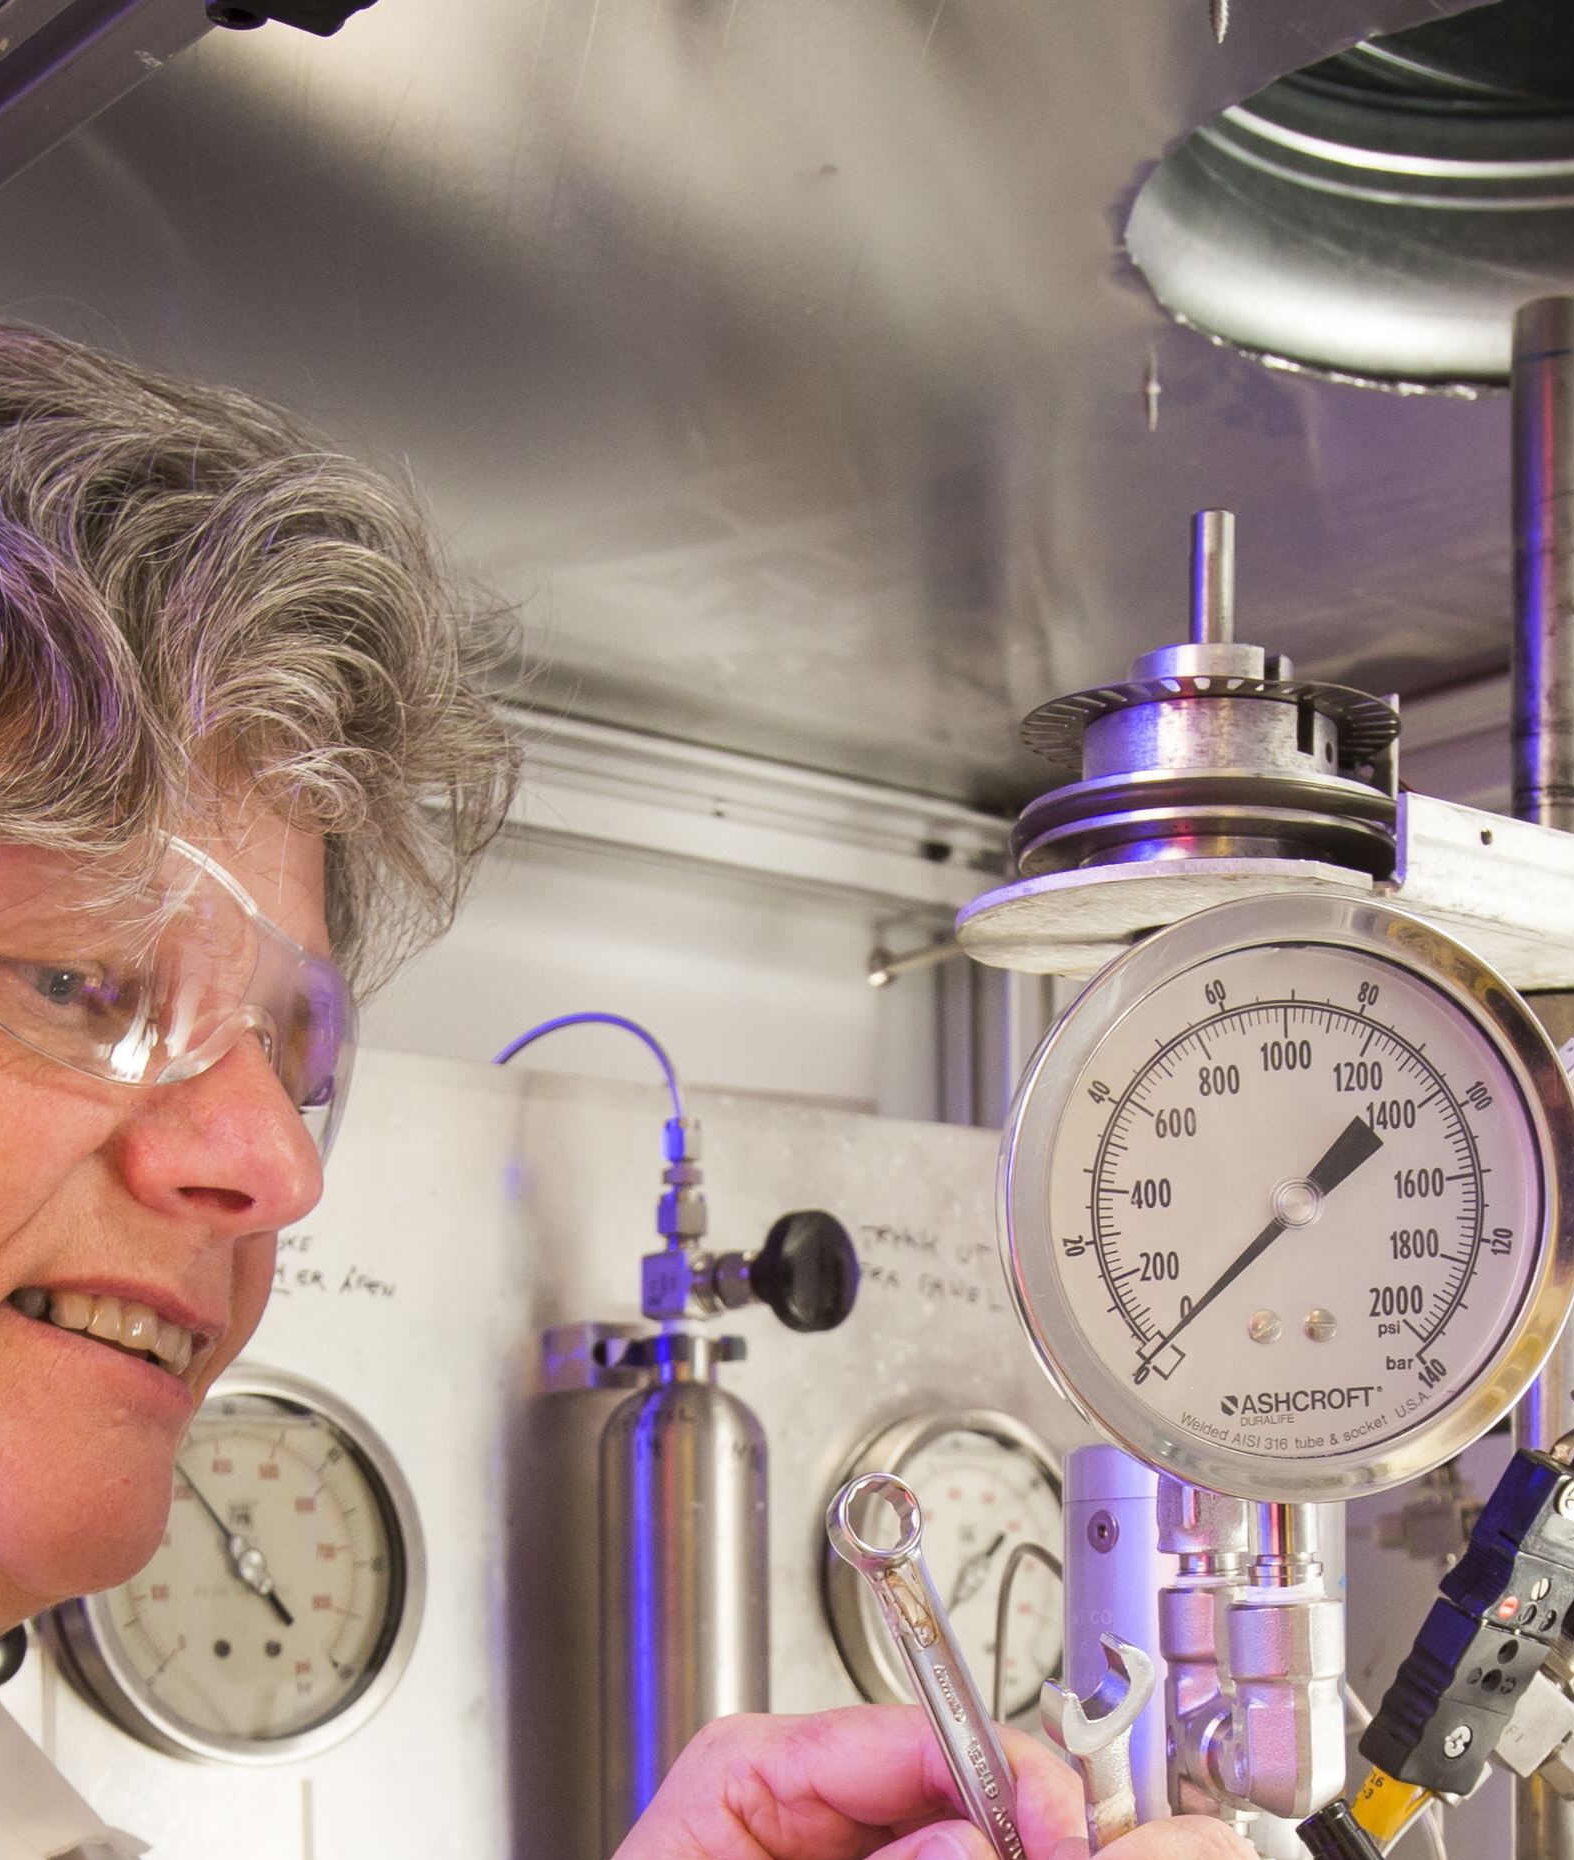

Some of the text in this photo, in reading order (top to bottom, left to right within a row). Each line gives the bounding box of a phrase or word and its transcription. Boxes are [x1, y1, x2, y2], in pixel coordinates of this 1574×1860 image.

[1204, 979, 1226, 1005] 60
[1357, 981, 1380, 1006] 80
[1260, 1040, 1312, 1072] 1000
[1086, 1079, 1111, 1104] 40
[1199, 1065, 1240, 1097] 800
[1333, 1061, 1383, 1092] 1200
[1464, 1080, 1493, 1112] 100
[1155, 1107, 1197, 1138] 600
[1366, 1099, 1417, 1130] 1400
[1130, 1178, 1172, 1208] 400
[1394, 1167, 1445, 1198] 1600
[1063, 1235, 1085, 1258] 20
[1390, 1229, 1439, 1260] 1800
[1489, 1227, 1515, 1256] 120
[1139, 1251, 1179, 1282] 200
[1369, 1284, 1423, 1317] 2000
[1378, 1320, 1400, 1338] psi
[1386, 1356, 1414, 1370] bar
[1418, 1358, 1447, 1389] 140
[1240, 1386, 1375, 1415] ASHCROFT
[1181, 1391, 1433, 1450] Welded AISI 316 tube & socket U.S.A.
[1240, 1414, 1294, 1427] DURALIFE
